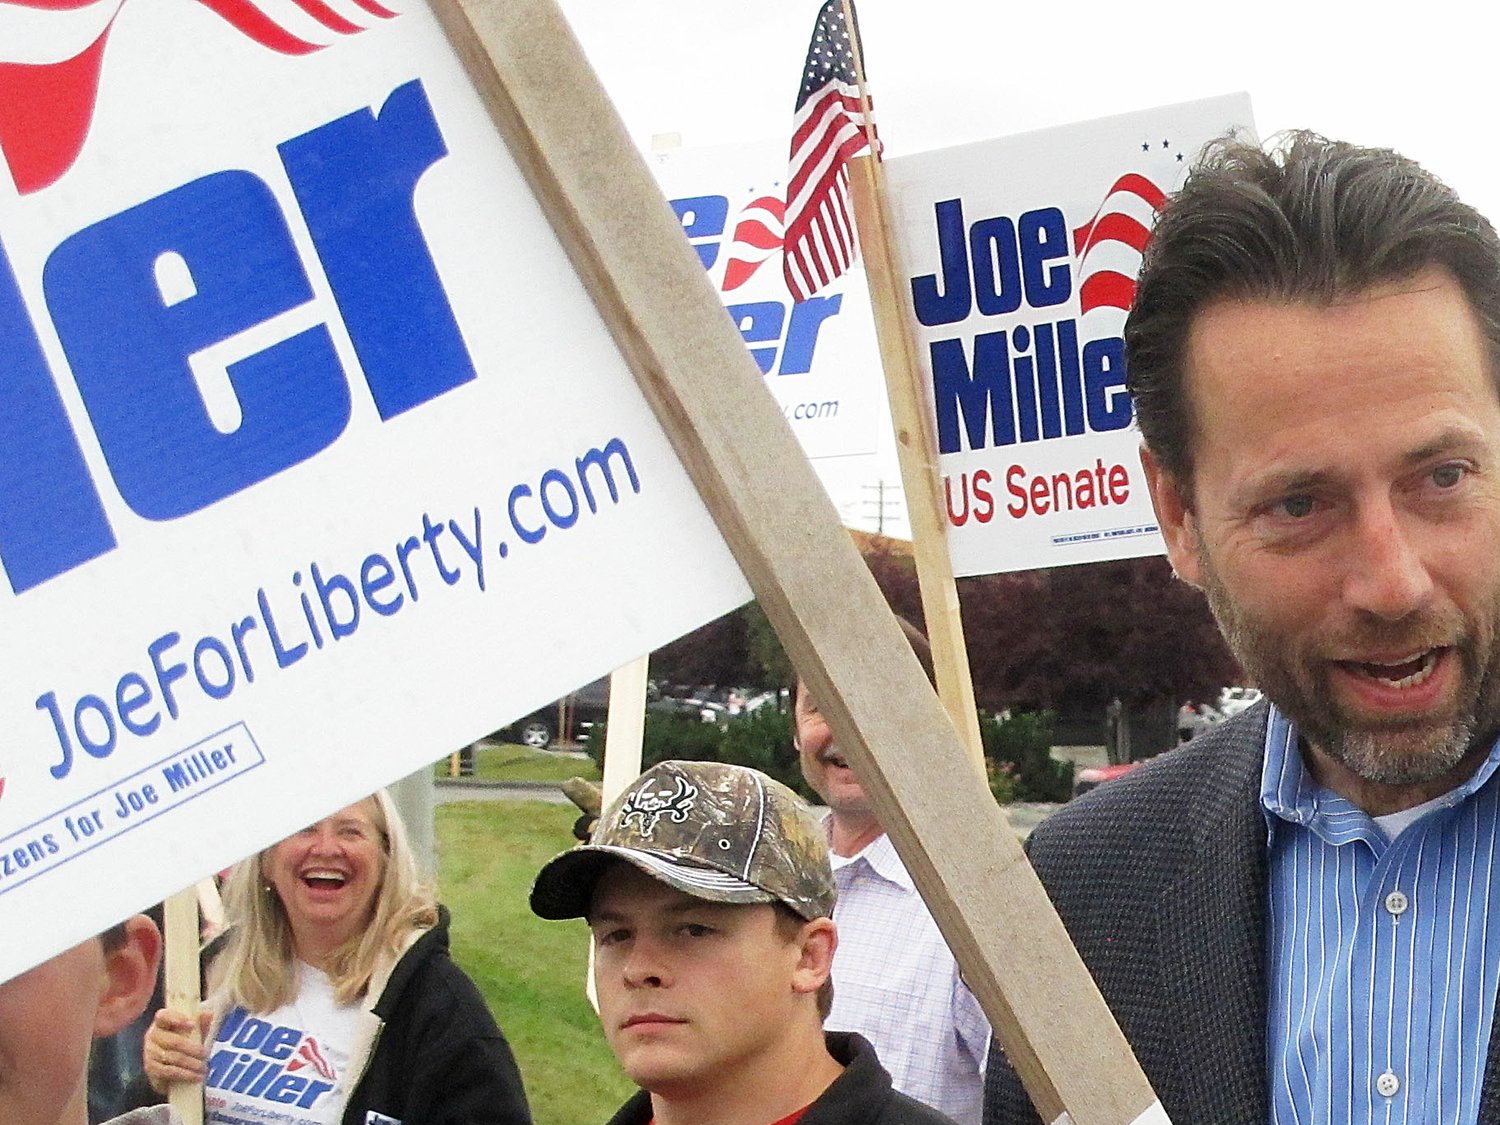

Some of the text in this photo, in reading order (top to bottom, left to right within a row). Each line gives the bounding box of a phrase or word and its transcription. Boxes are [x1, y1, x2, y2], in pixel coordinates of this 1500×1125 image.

[910, 197, 1072, 327] Joe
[929, 318, 1135, 455] Mille
[945, 458, 1130, 528] US Senate
[36, 436, 641, 781] JoeForLiberty.com
[0, 742, 237, 881] zens for Joe Miller
[215, 1005, 303, 1061] Joe
